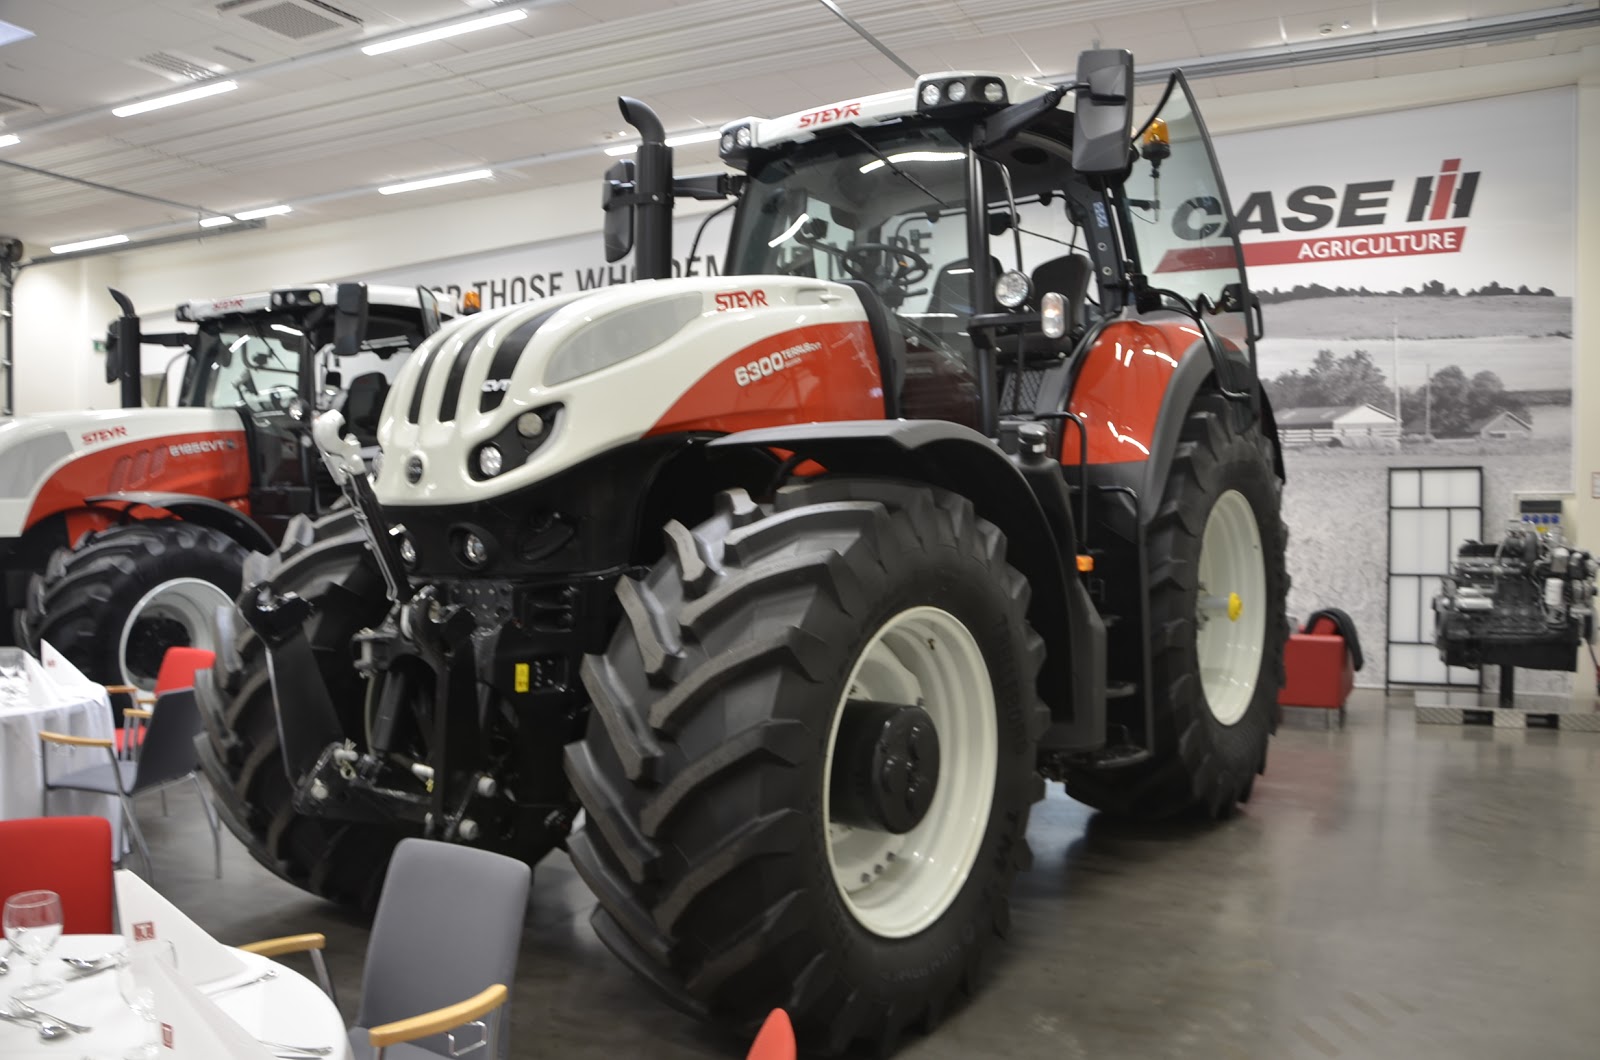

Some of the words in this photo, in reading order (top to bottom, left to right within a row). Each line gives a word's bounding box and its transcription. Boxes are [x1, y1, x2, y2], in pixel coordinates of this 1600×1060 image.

[798, 102, 861, 128] STEYR
[1171, 179, 1395, 241] CASE
[1297, 231, 1457, 260] AGRICULTURE
[472, 272, 563, 309] THOSE
[576, 263, 636, 291] WH
[714, 289, 769, 312] STEYR
[734, 351, 785, 387] 6300
[82, 425, 128, 445] STEYR
